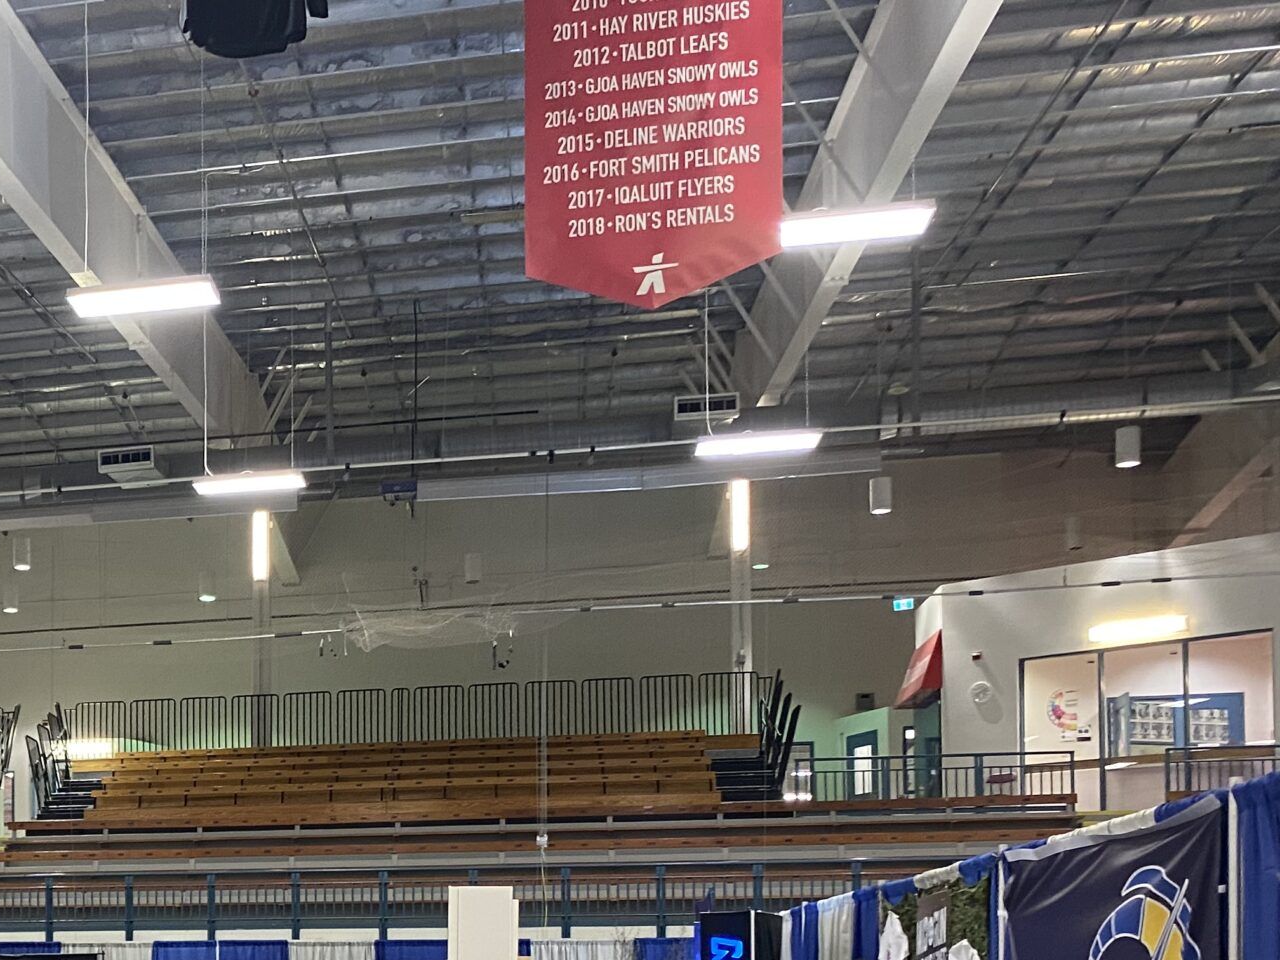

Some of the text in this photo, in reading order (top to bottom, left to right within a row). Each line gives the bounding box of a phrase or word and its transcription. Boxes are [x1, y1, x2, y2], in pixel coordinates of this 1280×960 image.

[553, 1, 750, 42] 2011 HAY RIVER HUSKIES
[573, 31, 729, 68] 2012 TALBOT LEAFS
[545, 59, 758, 100] 2013 GJOA HAVEN SNOWY OWLS
[545, 88, 758, 129] 2014 GJOA HAVEN SNOWY OWLS
[557, 116, 745, 154] 2015 DELINE WARRIORS
[543, 144, 761, 185] 2016 FORT SMITH PELICANS
[568, 175, 735, 210] 2017 IQALUIT FLYERS
[568, 218, 605, 238] 2018
[666, 204, 735, 228] RENTALS
